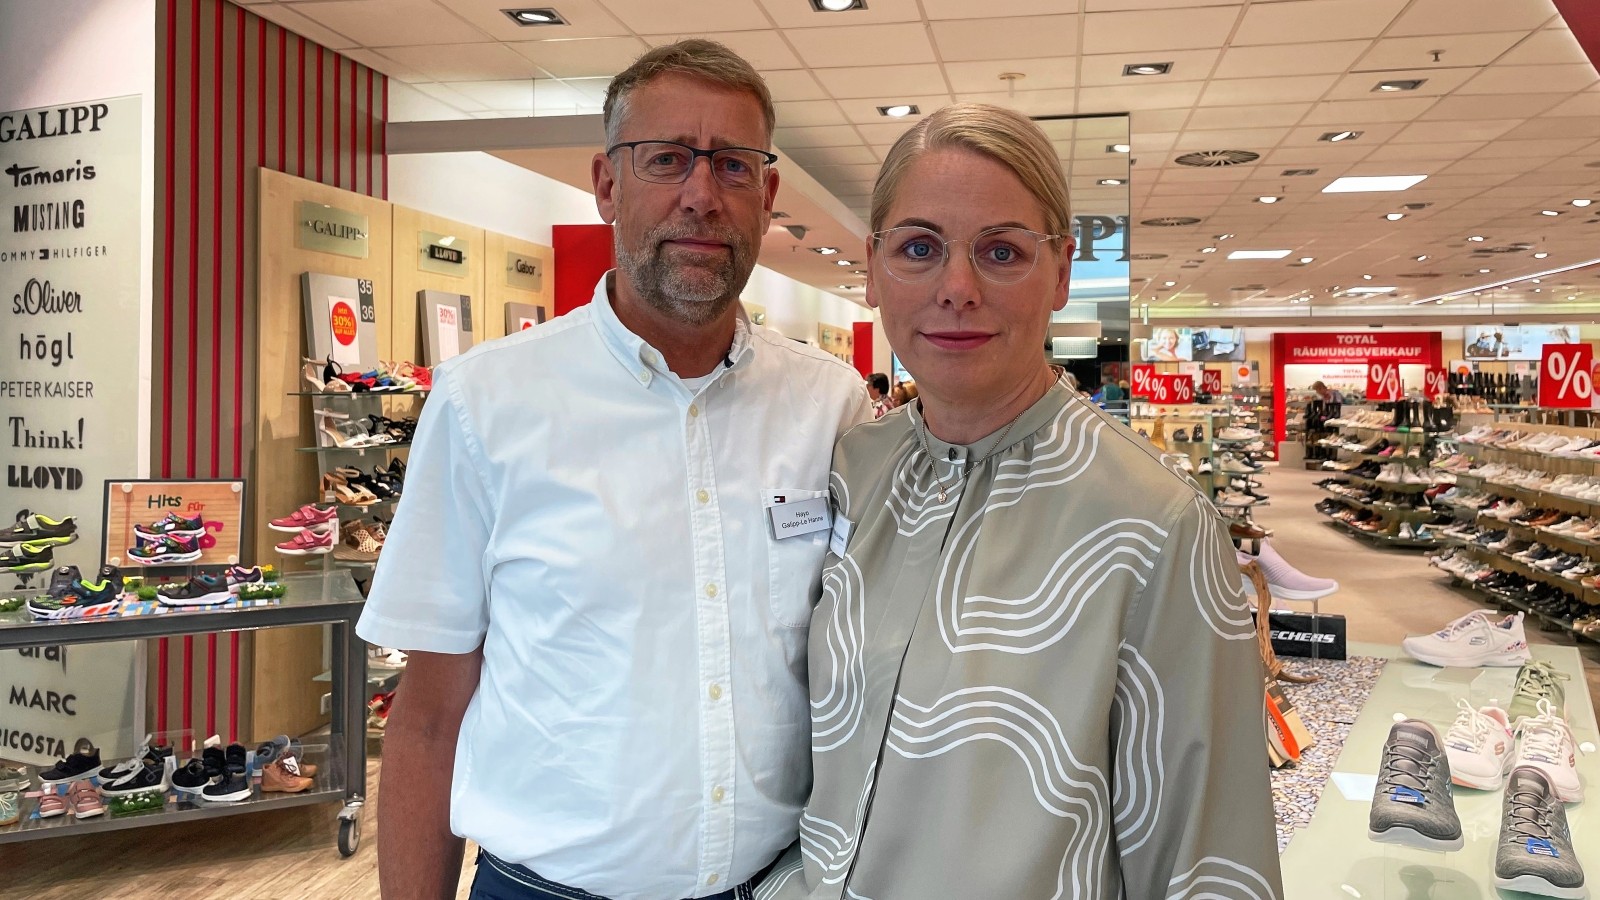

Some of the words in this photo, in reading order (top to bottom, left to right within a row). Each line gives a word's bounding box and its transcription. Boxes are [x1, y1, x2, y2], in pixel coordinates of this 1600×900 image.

[0, 104, 109, 142] GALIPP
[14, 199, 85, 233] MUSTANG
[0, 251, 36, 263] OMMY
[53, 245, 107, 258] HILFIGER
[434, 247, 459, 261] LLOYD
[515, 259, 536, 276] Gabor
[12, 277, 83, 315] s.Oliver
[359, 280, 373, 294] 35
[361, 305, 374, 320] 36
[1293, 345, 1422, 357] RÄUMUNGSVERKAUF
[1336, 335, 1377, 345] TOTAL
[1547, 351, 1592, 400] %
[0, 381, 42, 398] PETER
[44, 381, 94, 398] KAISER
[1152, 378, 1167, 400] %
[1173, 378, 1190, 400] %
[9, 416, 84, 450] Think!
[8, 465, 83, 491] LLOYD
[1269, 630, 1336, 644] ECHERS
[9, 684, 77, 716] MARC
[0, 728, 66, 759] ICOSTA
